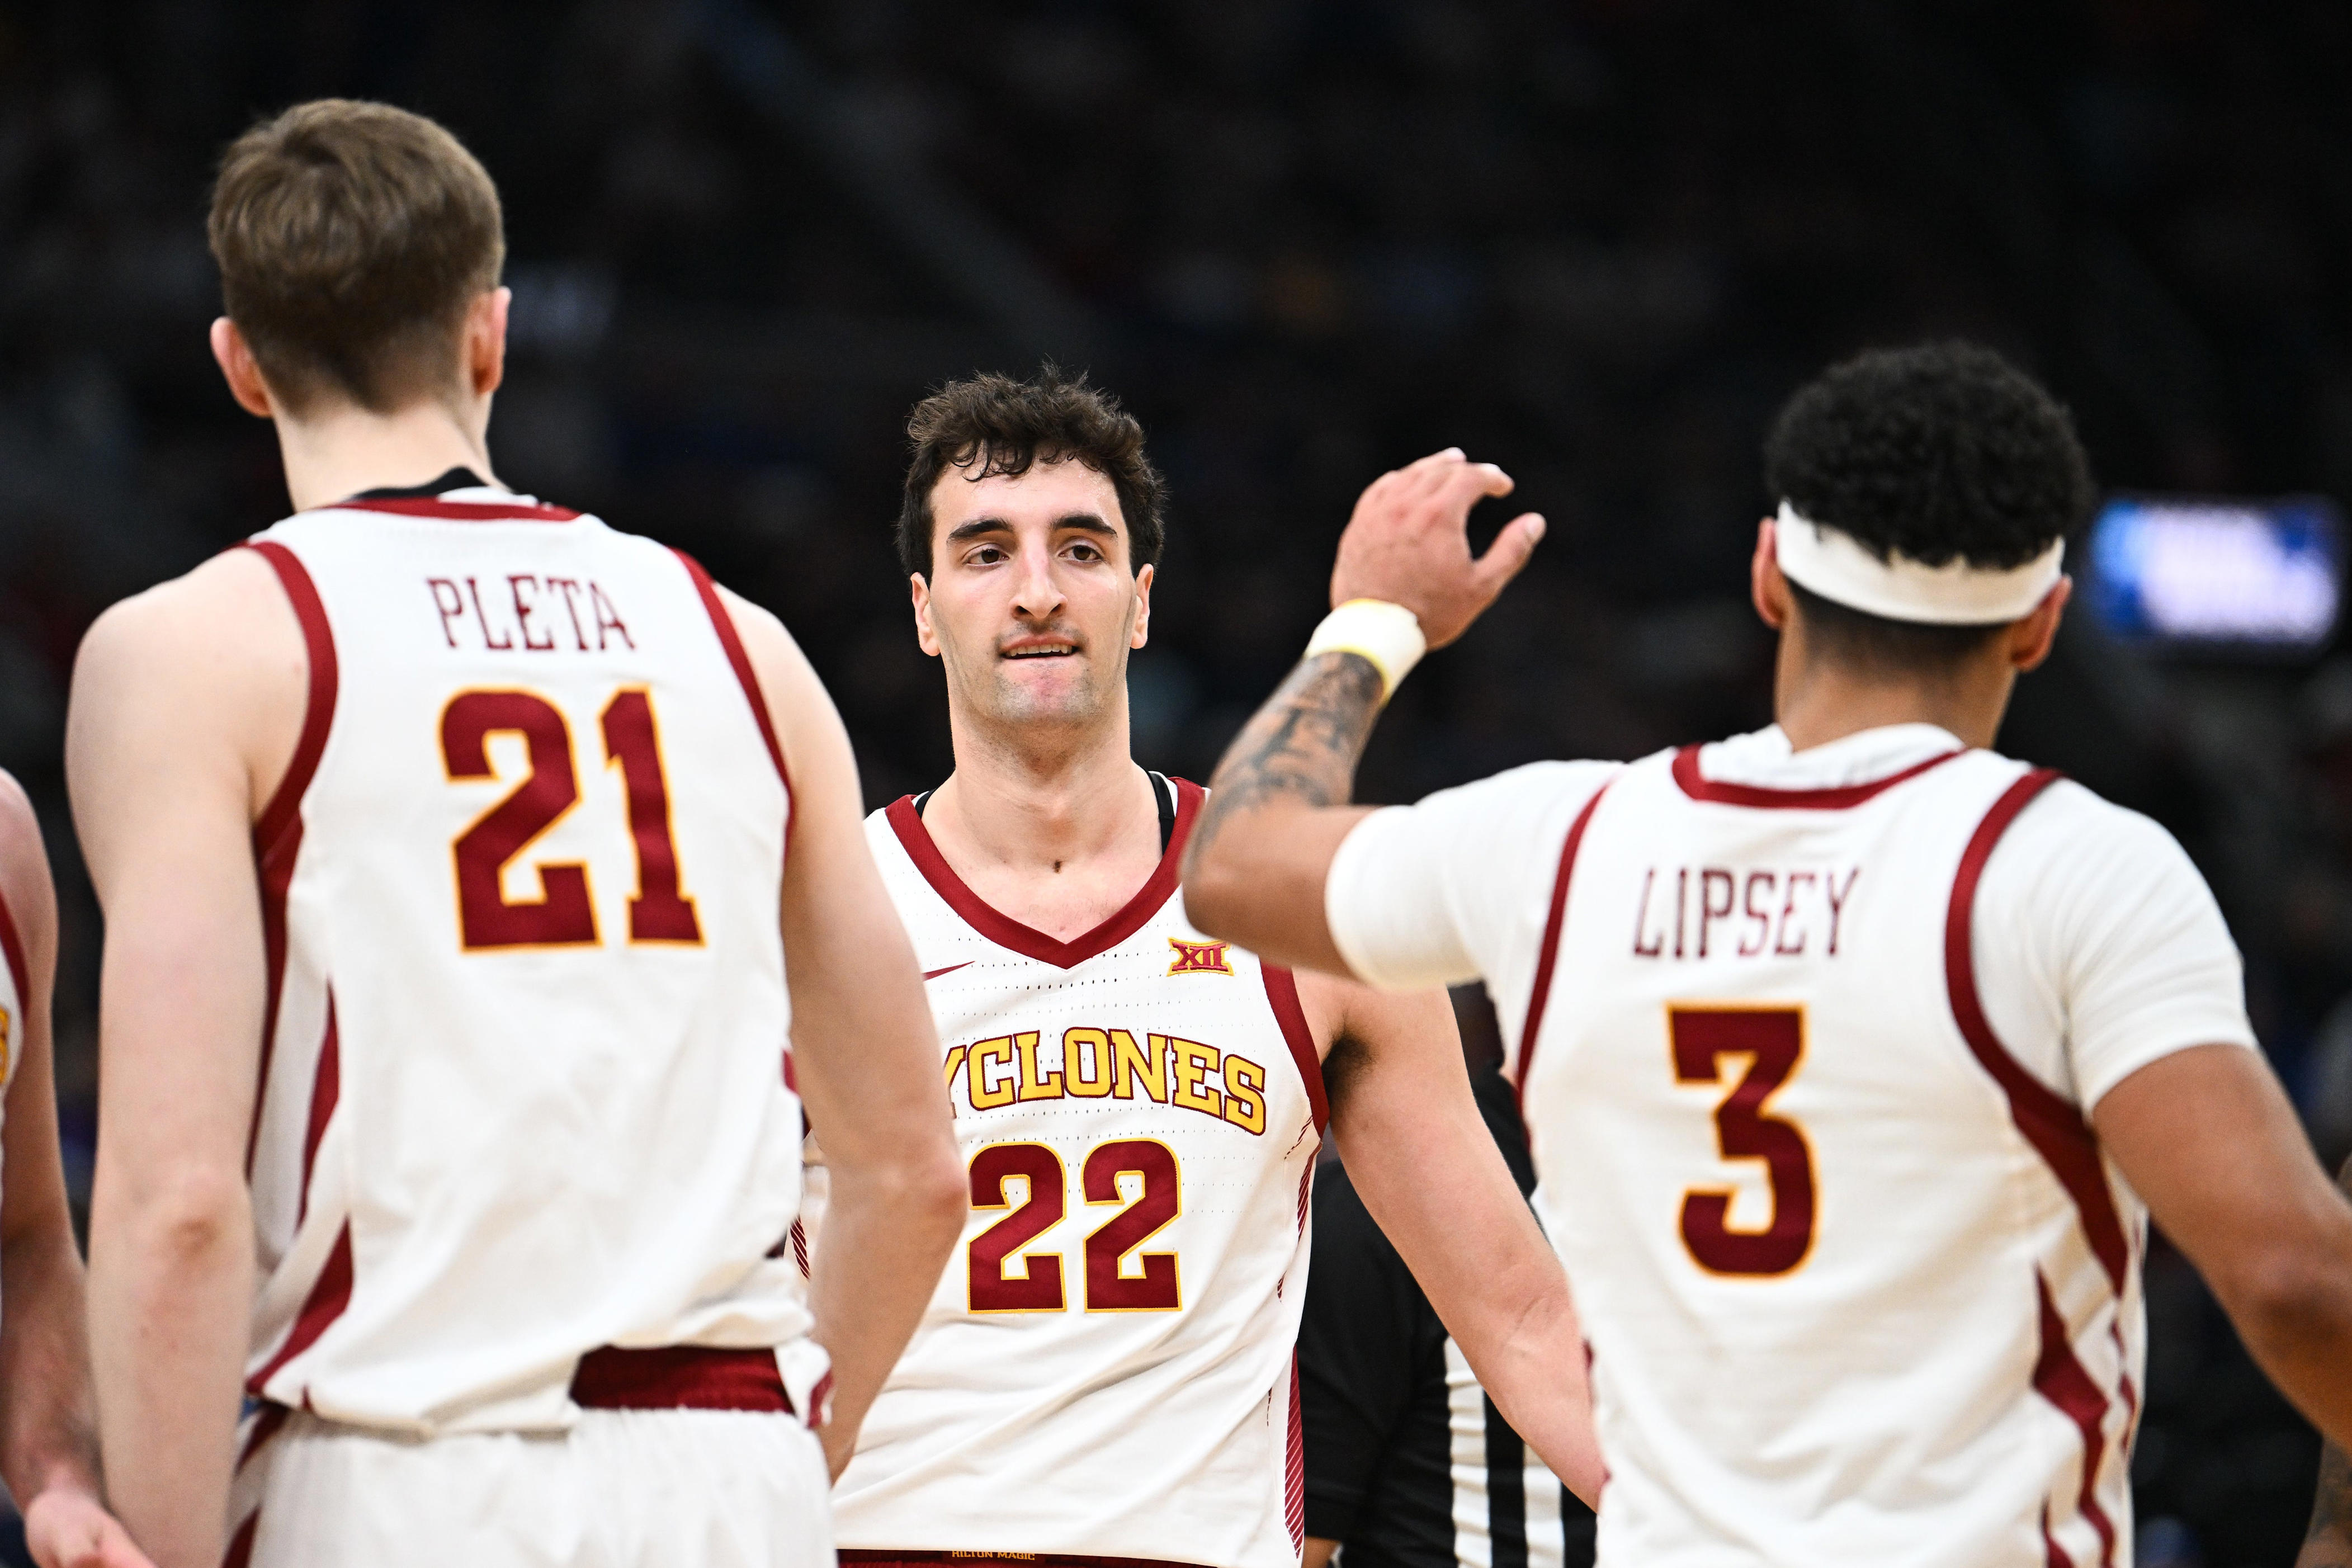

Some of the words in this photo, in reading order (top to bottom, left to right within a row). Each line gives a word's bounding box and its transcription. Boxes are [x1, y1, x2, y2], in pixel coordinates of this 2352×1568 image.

[426, 574, 636, 650] PLETA
[436, 682, 707, 954] 21
[1171, 941, 1229, 972] XII
[1633, 866, 1861, 959] LIPSEY
[1664, 1000, 1820, 1282] 3
[967, 1137, 1183, 1314] 22
[997, 1552, 1035, 1560] MAGIC
